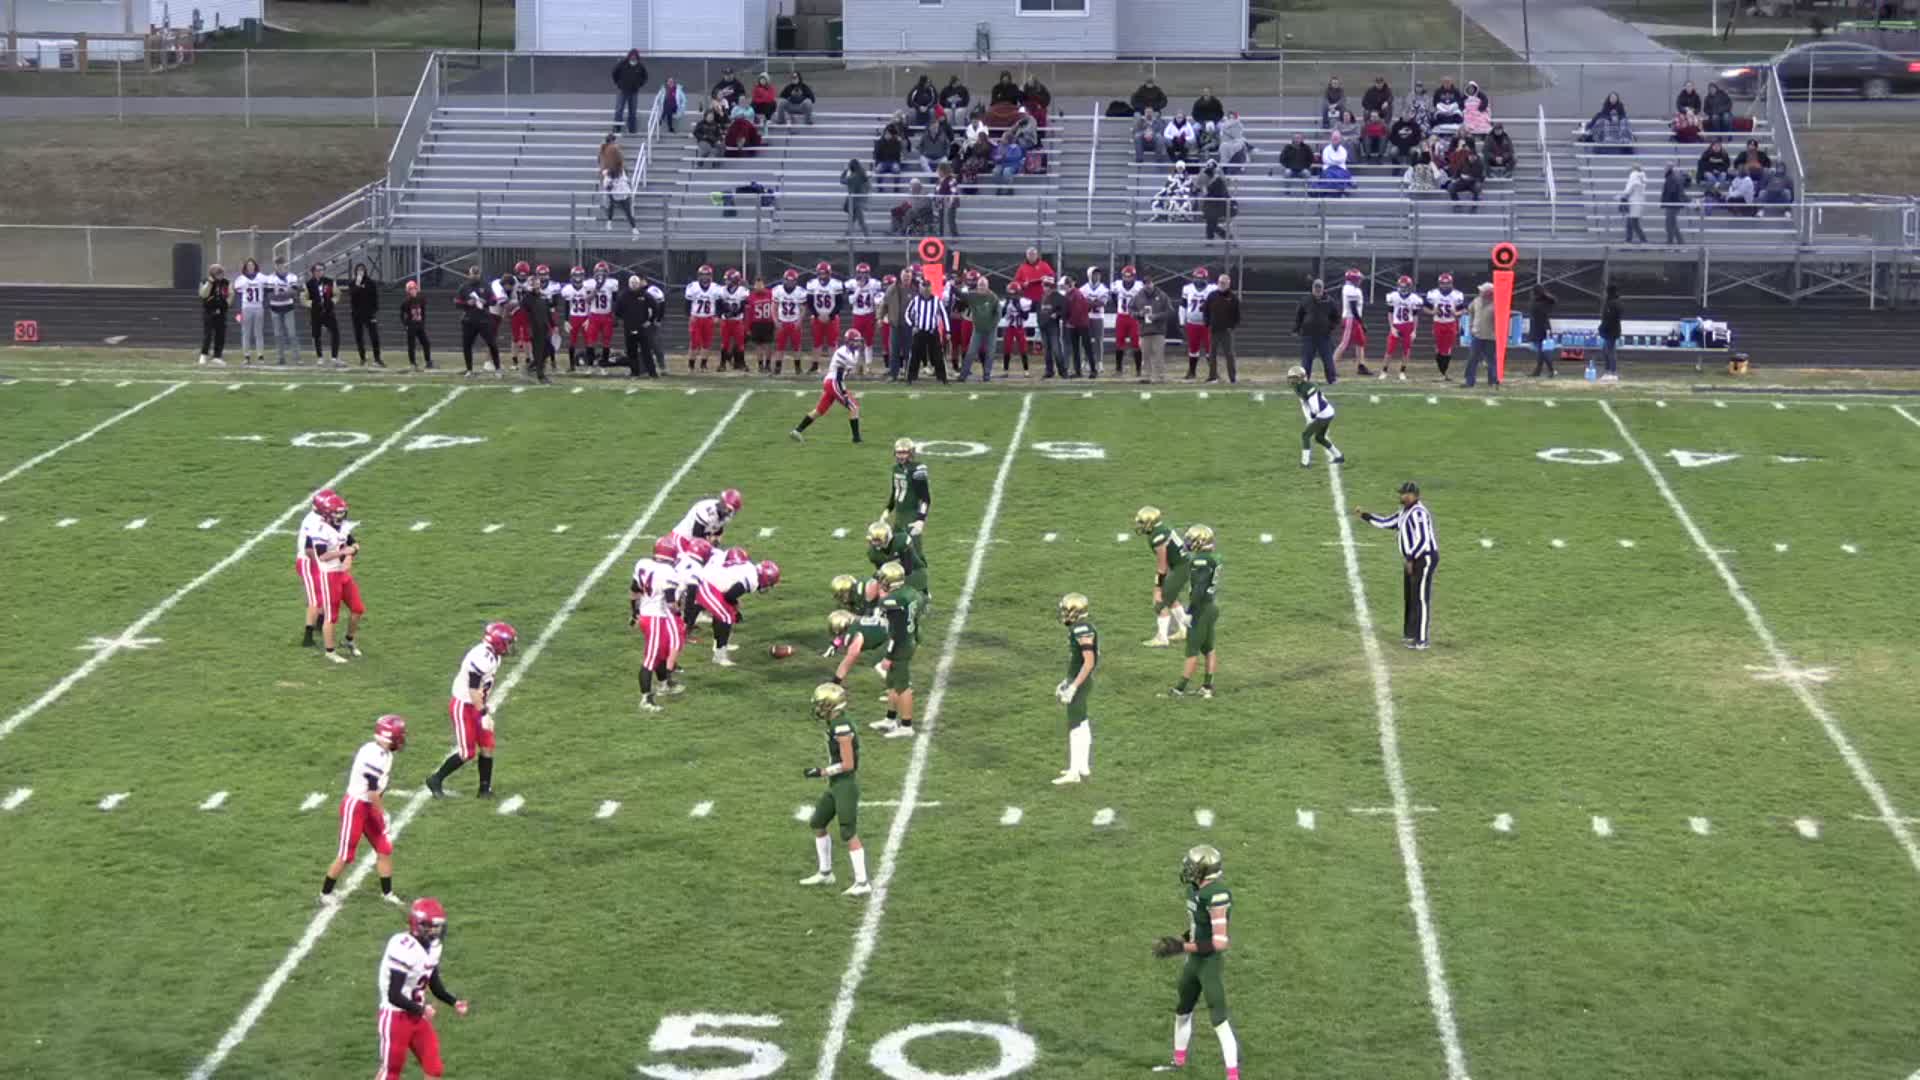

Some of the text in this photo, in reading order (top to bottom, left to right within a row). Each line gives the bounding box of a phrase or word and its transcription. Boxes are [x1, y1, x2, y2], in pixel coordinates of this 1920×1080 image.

[246, 287, 259, 302] 31
[594, 294, 607, 309] 19
[816, 294, 832, 309] 56
[755, 303, 770, 319] 58
[782, 302, 796, 316] 52
[16, 323, 35, 339] 30
[637, 1012, 1039, 1080] 50
